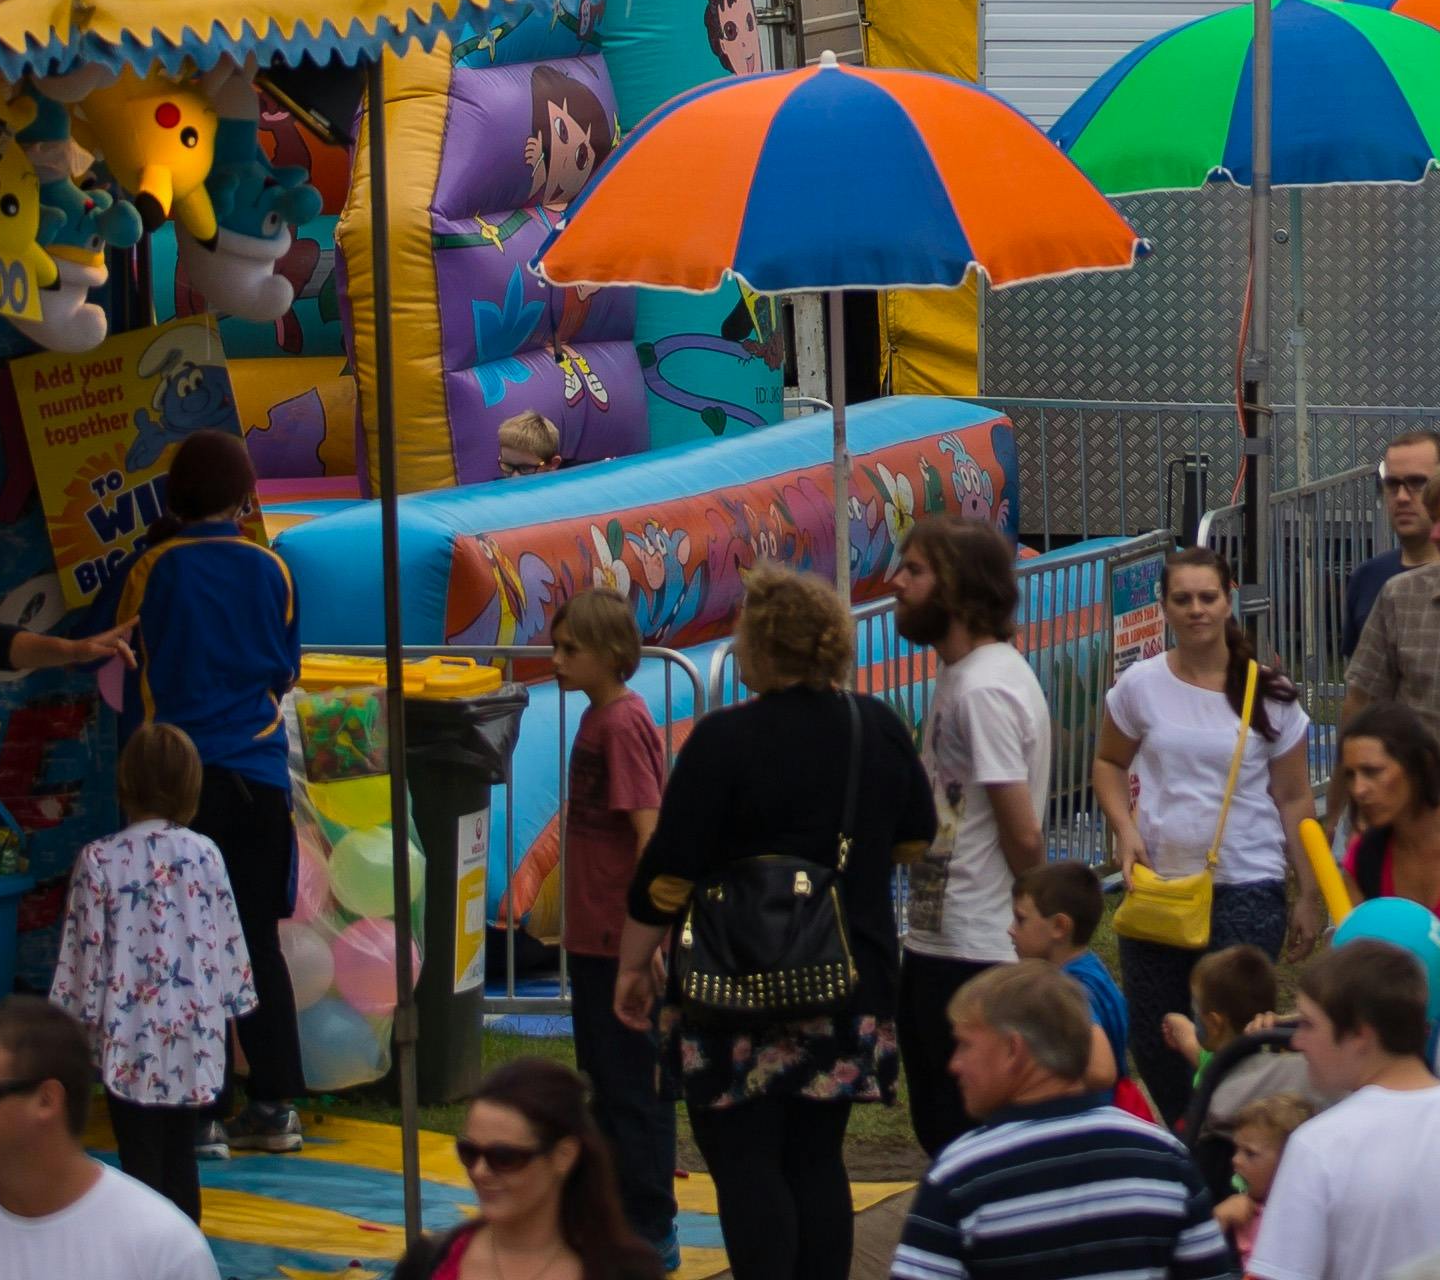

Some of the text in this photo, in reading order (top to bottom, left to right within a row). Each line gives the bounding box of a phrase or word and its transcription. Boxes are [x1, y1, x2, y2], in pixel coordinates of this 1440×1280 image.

[33, 356, 124, 392] Add your
[39, 384, 125, 419] numbers
[44, 411, 129, 447] together
[91, 471, 124, 497] TO
